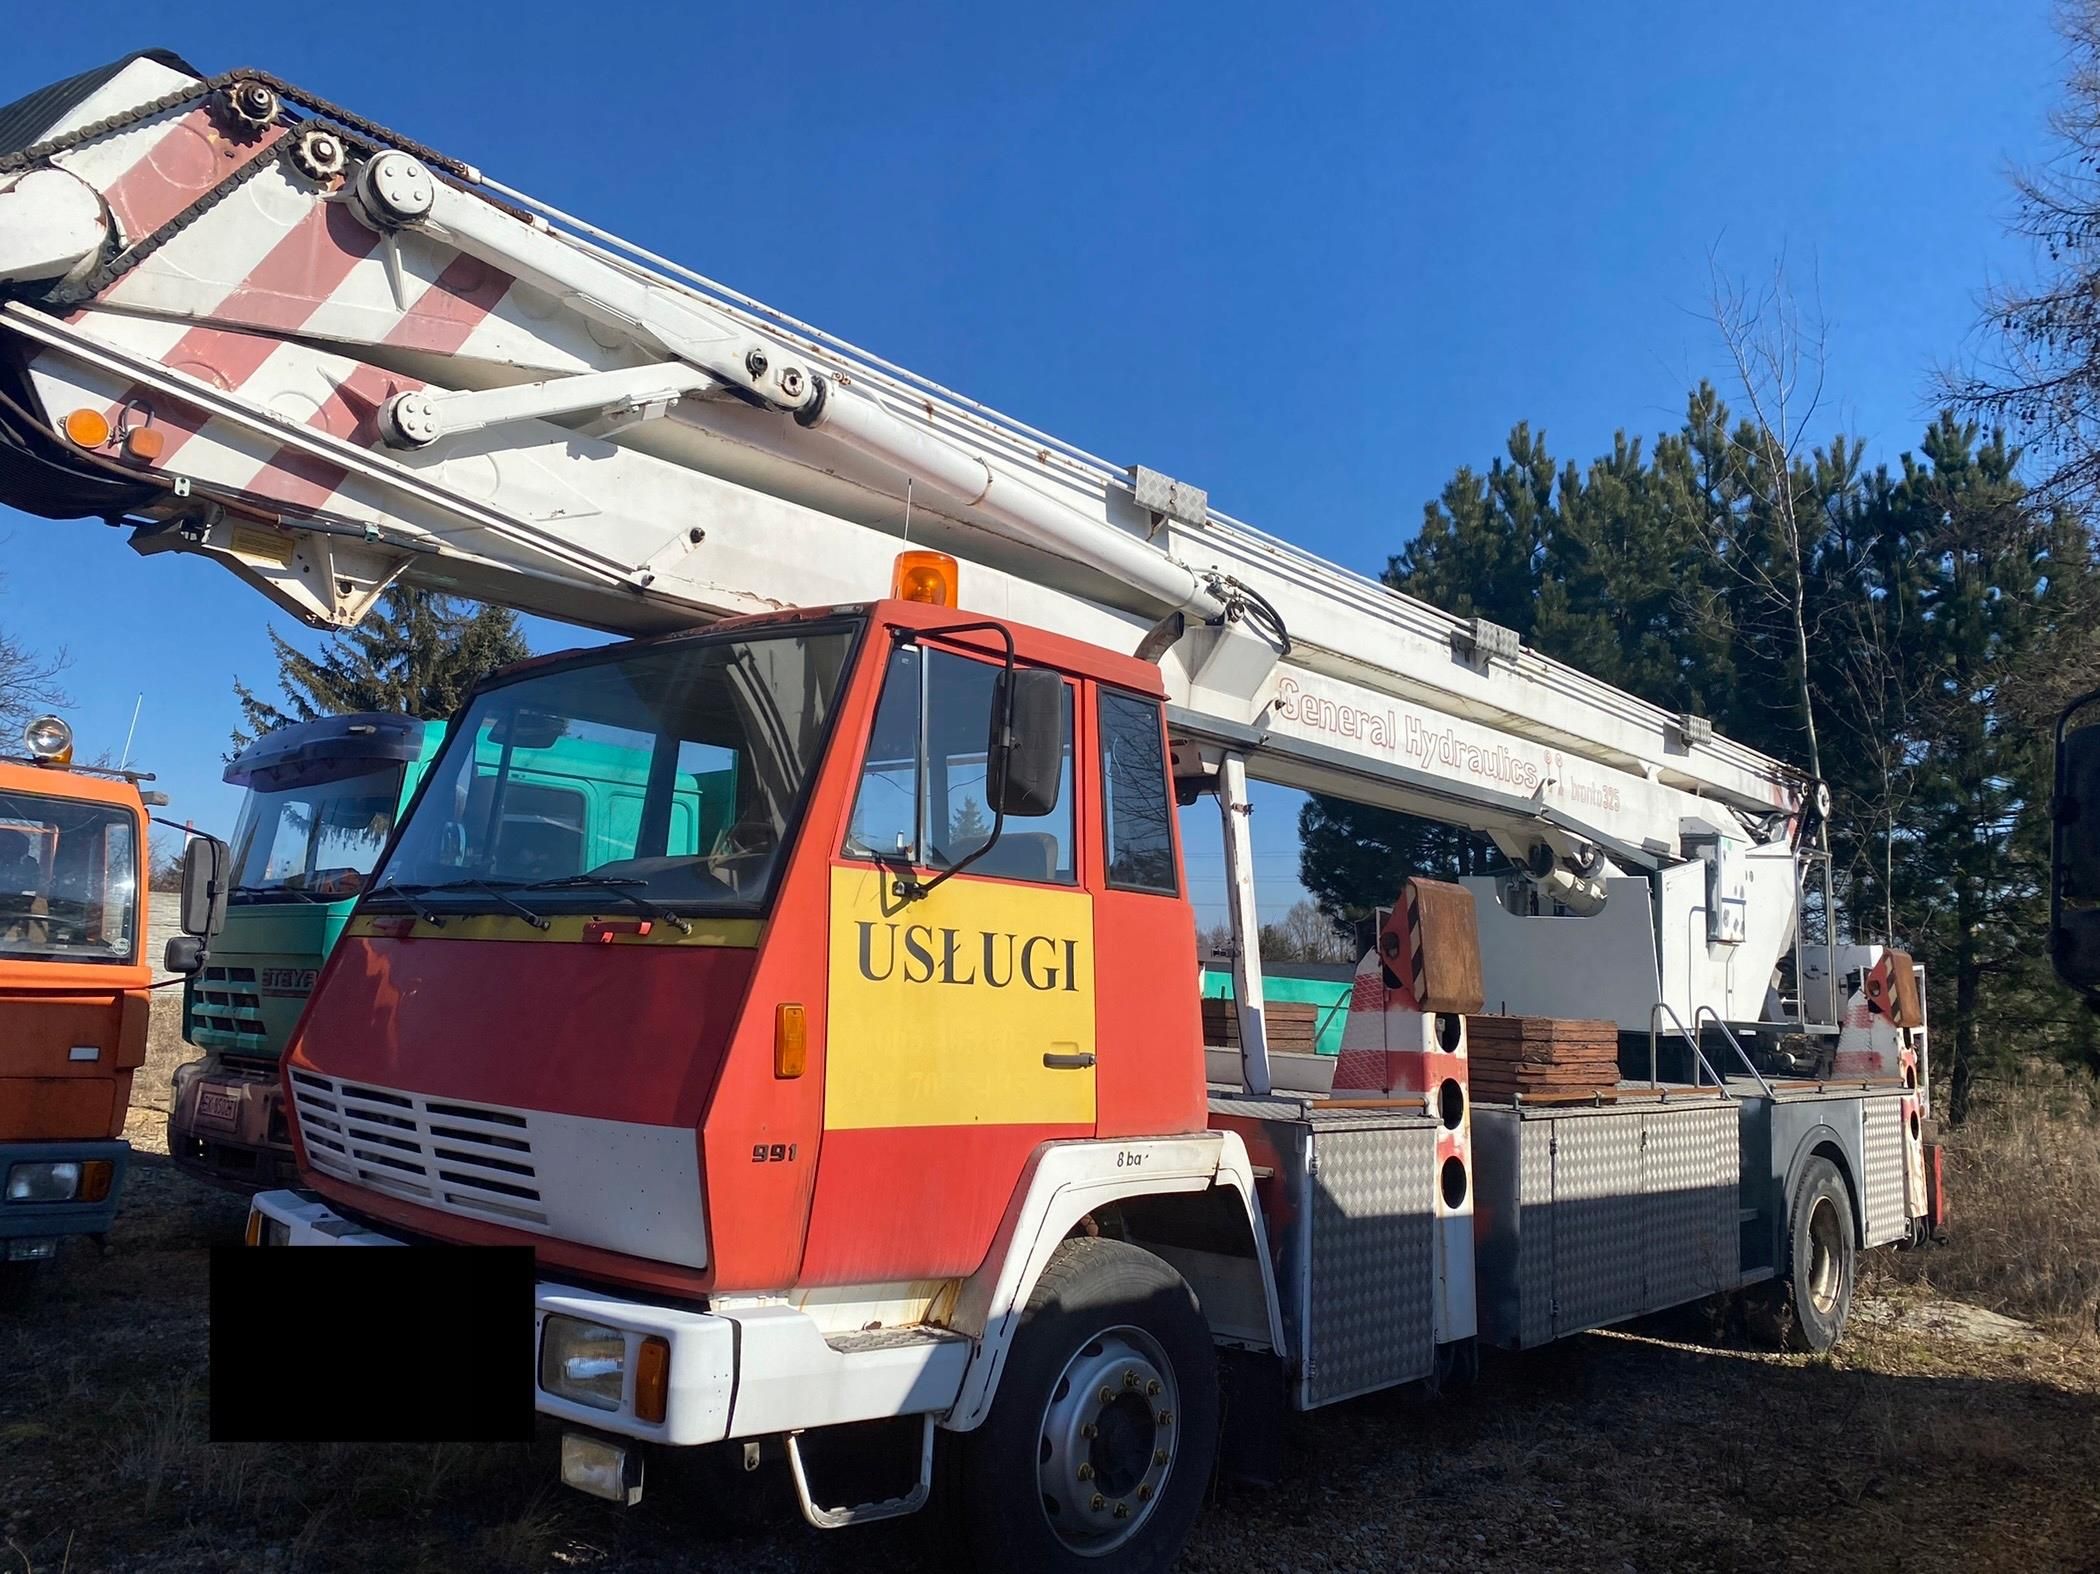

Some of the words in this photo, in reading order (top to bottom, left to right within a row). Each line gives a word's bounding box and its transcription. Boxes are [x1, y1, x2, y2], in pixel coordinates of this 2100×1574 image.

[1279, 677, 1396, 749] General
[1405, 714, 1538, 789] Hydraulics
[854, 920, 1079, 992] USŁUGI
[751, 1143, 798, 1163] 991
[1117, 1151, 1125, 1168] 8
[1126, 1151, 1150, 1167] ba
